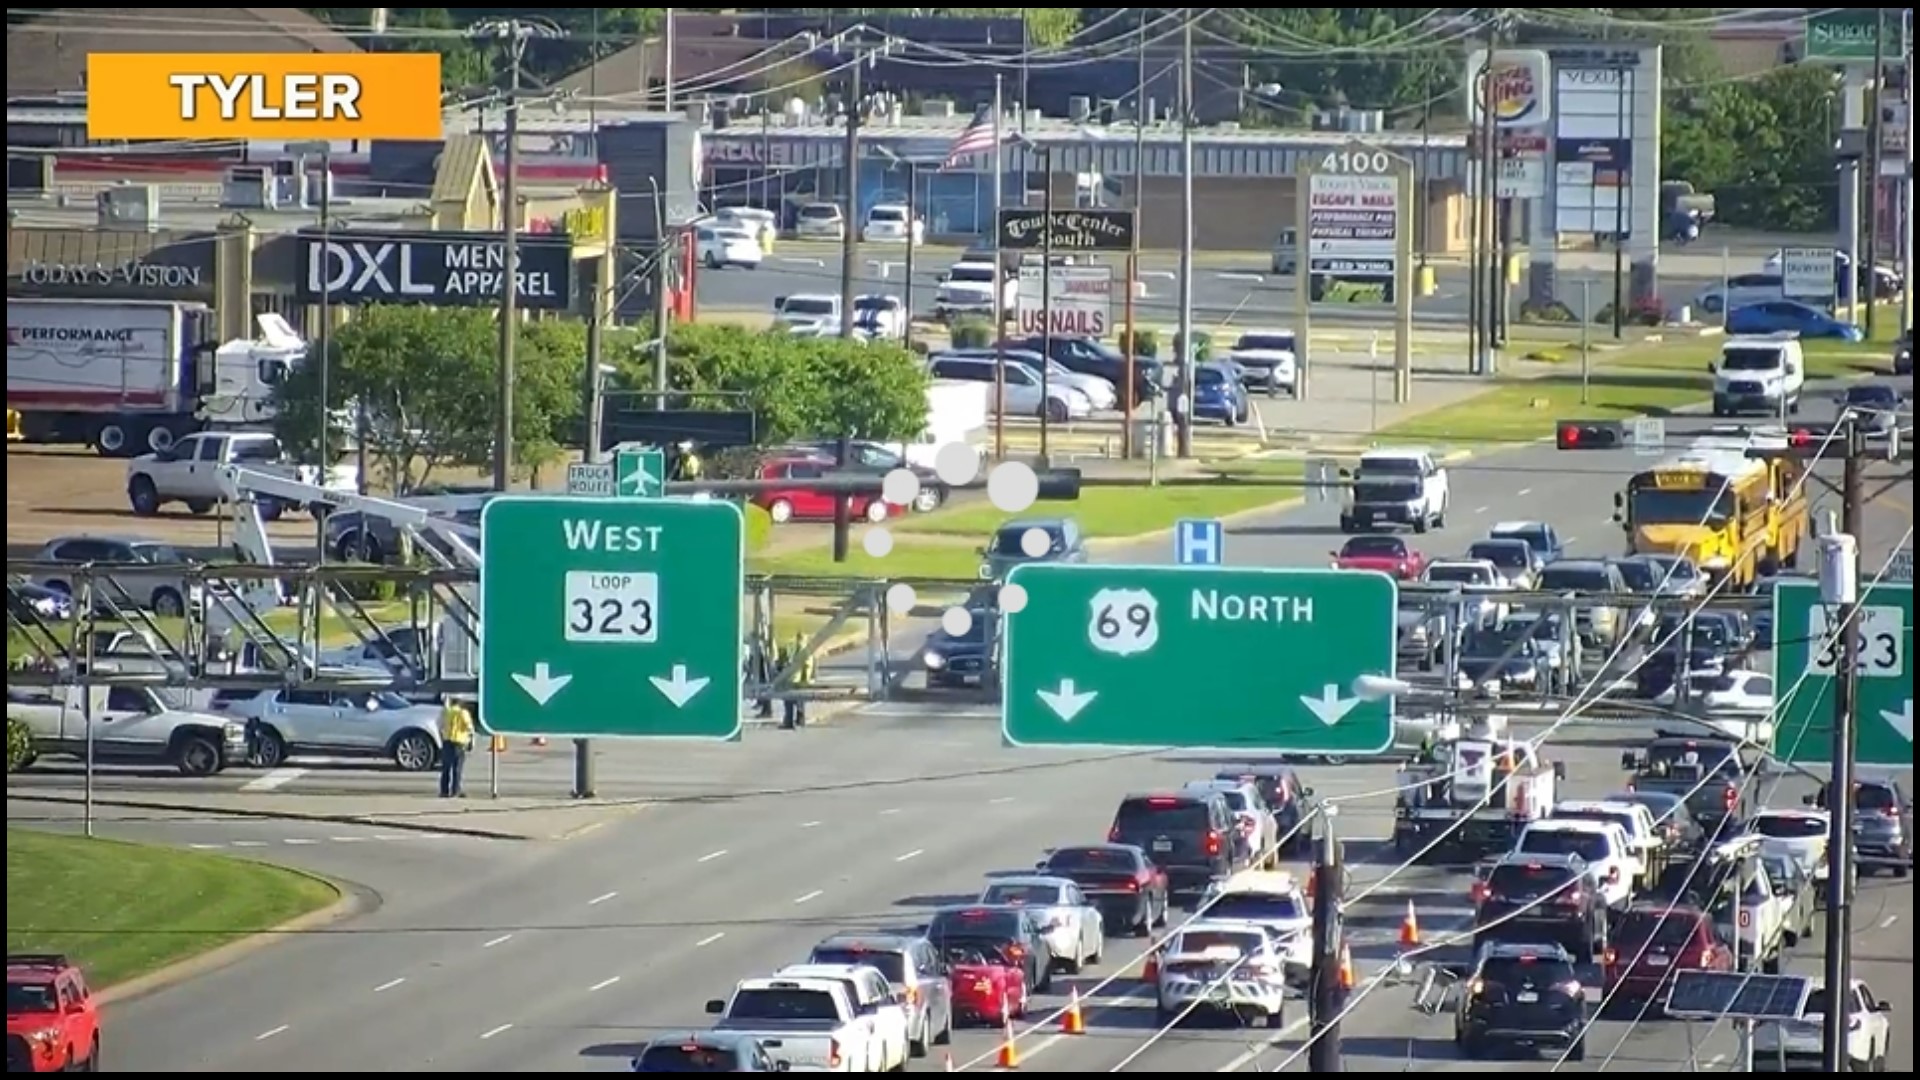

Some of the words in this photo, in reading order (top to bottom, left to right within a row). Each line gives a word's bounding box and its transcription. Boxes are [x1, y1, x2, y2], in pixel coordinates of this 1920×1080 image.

[1321, 151, 1389, 173] 4100
[1312, 193, 1355, 205] ESCAPE
[1361, 194, 1395, 206] NAILS
[1067, 214, 1126, 237] Center
[122, 260, 201, 286] VISION
[308, 242, 435, 294] DXL
[444, 271, 556, 295] APPAREL
[22, 327, 133, 341] PERFORMANCE
[571, 467, 610, 479] TRUCK
[570, 481, 609, 492] ROUTE
[562, 519, 663, 551] WEST
[1183, 523, 1216, 563] H
[591, 575, 632, 589] LOOP
[570, 598, 652, 635] 323
[1191, 588, 1314, 623] NORTH
[1097, 604, 1151, 639] 69
